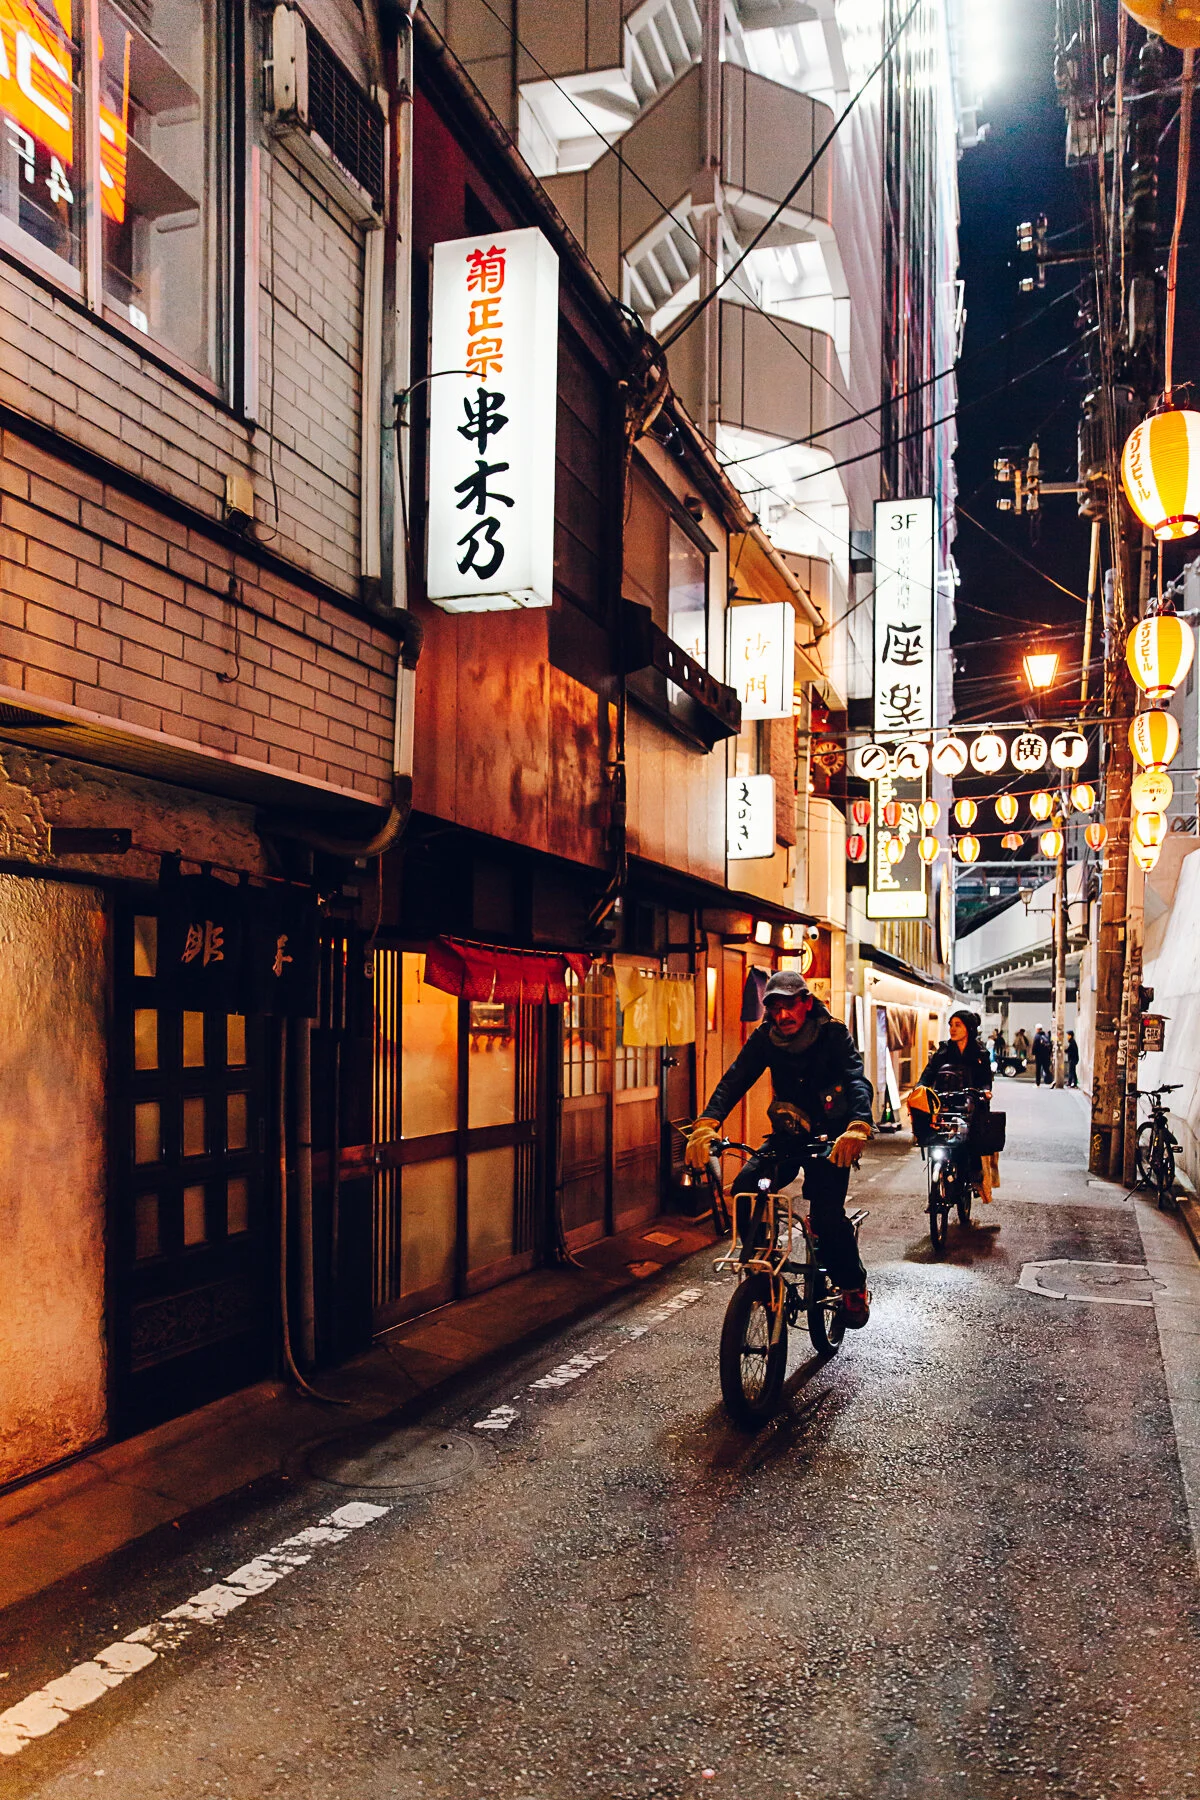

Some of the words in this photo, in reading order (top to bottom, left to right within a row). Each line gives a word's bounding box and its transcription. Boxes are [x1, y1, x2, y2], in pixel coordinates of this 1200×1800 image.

[466, 244, 507, 382] 菊正宗
[454, 386, 515, 580] 串木乃
[1130, 427, 1151, 502] キリンビール
[890, 513, 918, 531] 3F
[1140, 622, 1153, 672] キリンビール
[1135, 716, 1149, 753] キリンビール
